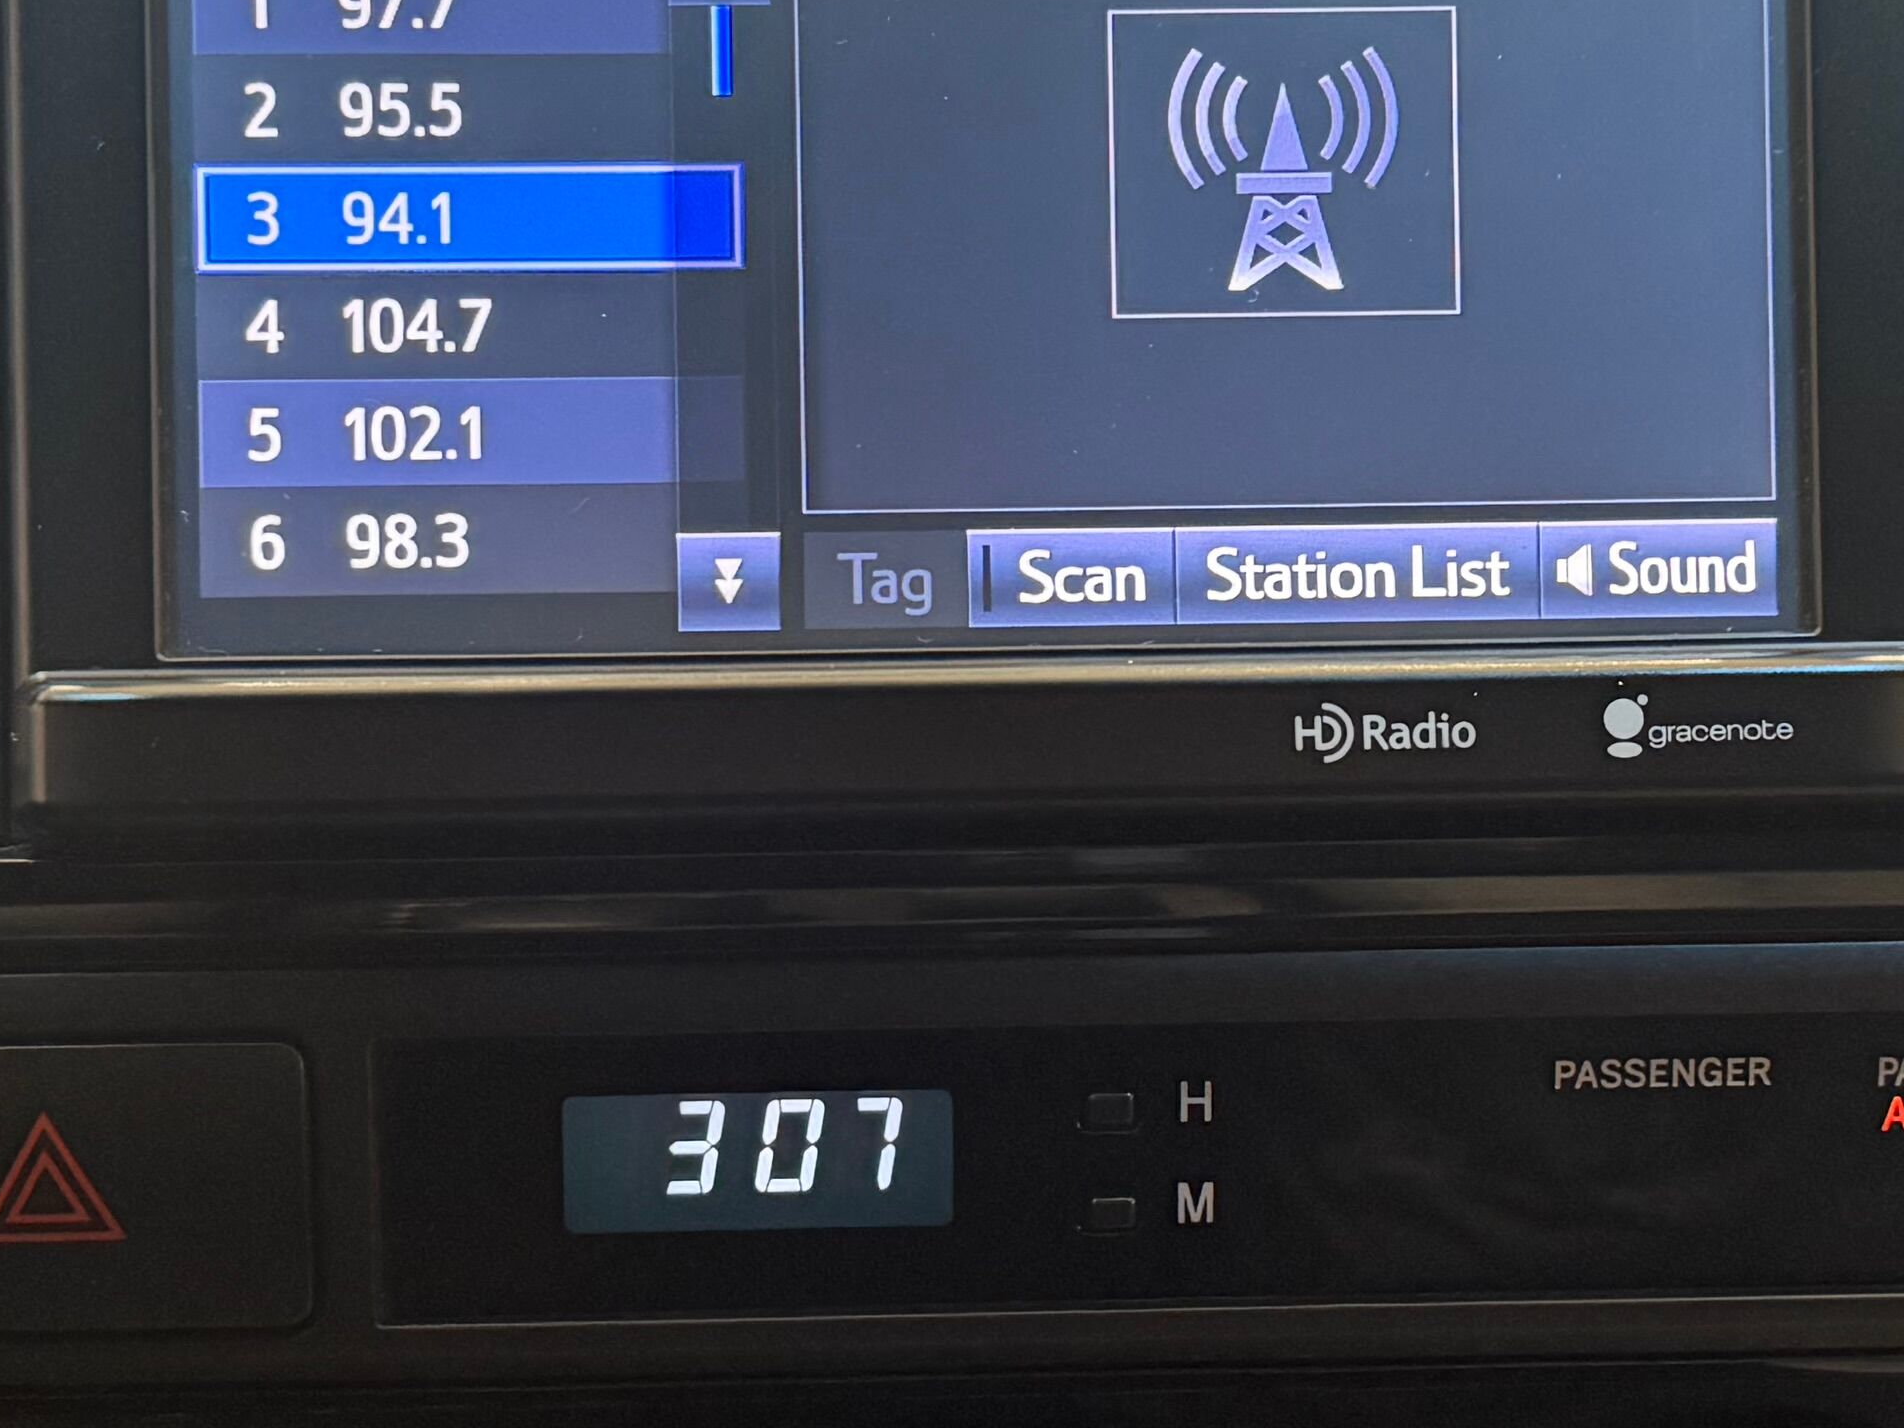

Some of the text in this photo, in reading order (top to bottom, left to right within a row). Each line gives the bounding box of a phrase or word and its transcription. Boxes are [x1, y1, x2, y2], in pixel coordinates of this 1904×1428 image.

[244, 81, 463, 138] 2 95.5
[246, 191, 454, 246] 3 94.1
[245, 297, 493, 354] 4 104.7
[247, 405, 485, 462] 5 102.1
[250, 512, 470, 571] 6 98.3
[1607, 539, 1757, 596] Sound
[837, 552, 933, 616] Tag
[1018, 549, 1147, 604] Scan
[1206, 542, 1511, 601] Station List
[1362, 710, 1477, 751] Radio
[1648, 719, 1795, 749] gracenote
[1554, 1056, 1773, 1090] PASSENGER
[1179, 1080, 1214, 1123] H
[1177, 1181, 1215, 1224] M
